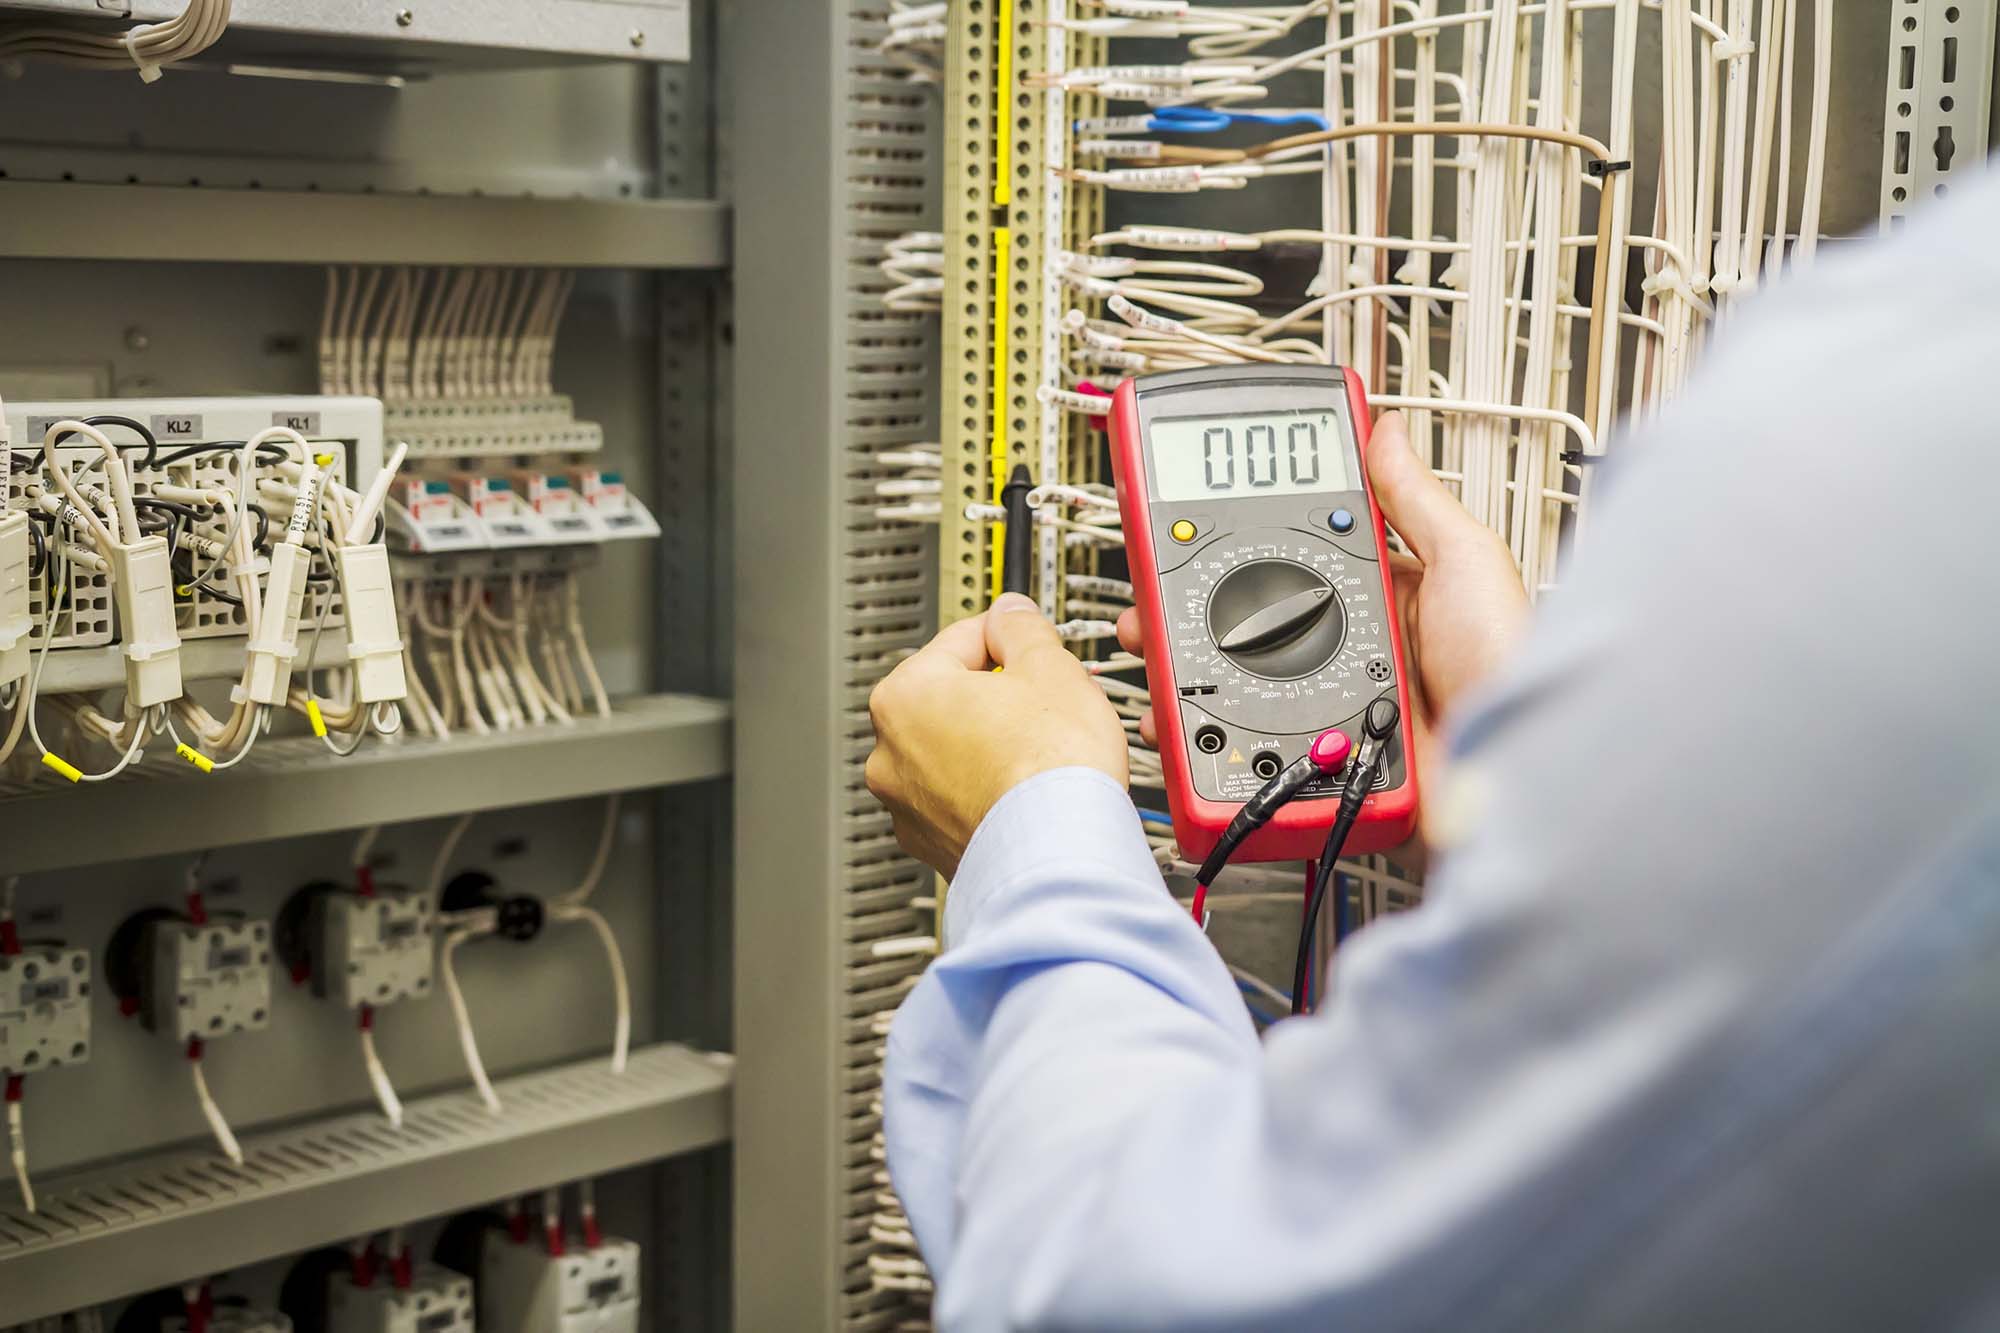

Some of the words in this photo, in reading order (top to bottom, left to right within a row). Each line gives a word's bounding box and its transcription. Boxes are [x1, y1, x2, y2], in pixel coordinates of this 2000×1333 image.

[167, 420, 192, 433] KL2
[287, 417, 310, 430] KL1
[1203, 422, 1319, 490] 000
[1238, 545, 1254, 553] 20M
[1223, 551, 1235, 559] 2M
[1314, 554, 1328, 562] 200
[1193, 561, 1202, 569] Ω
[1360, 627, 1366, 635] 2
[1356, 643, 1378, 651] 200m
[1319, 681, 1340, 689] 200m
[1242, 686, 1260, 694] 20m
[1304, 688, 1314, 696] 10
[1260, 691, 1282, 699] 200m
[1199, 715, 1207, 725] A
